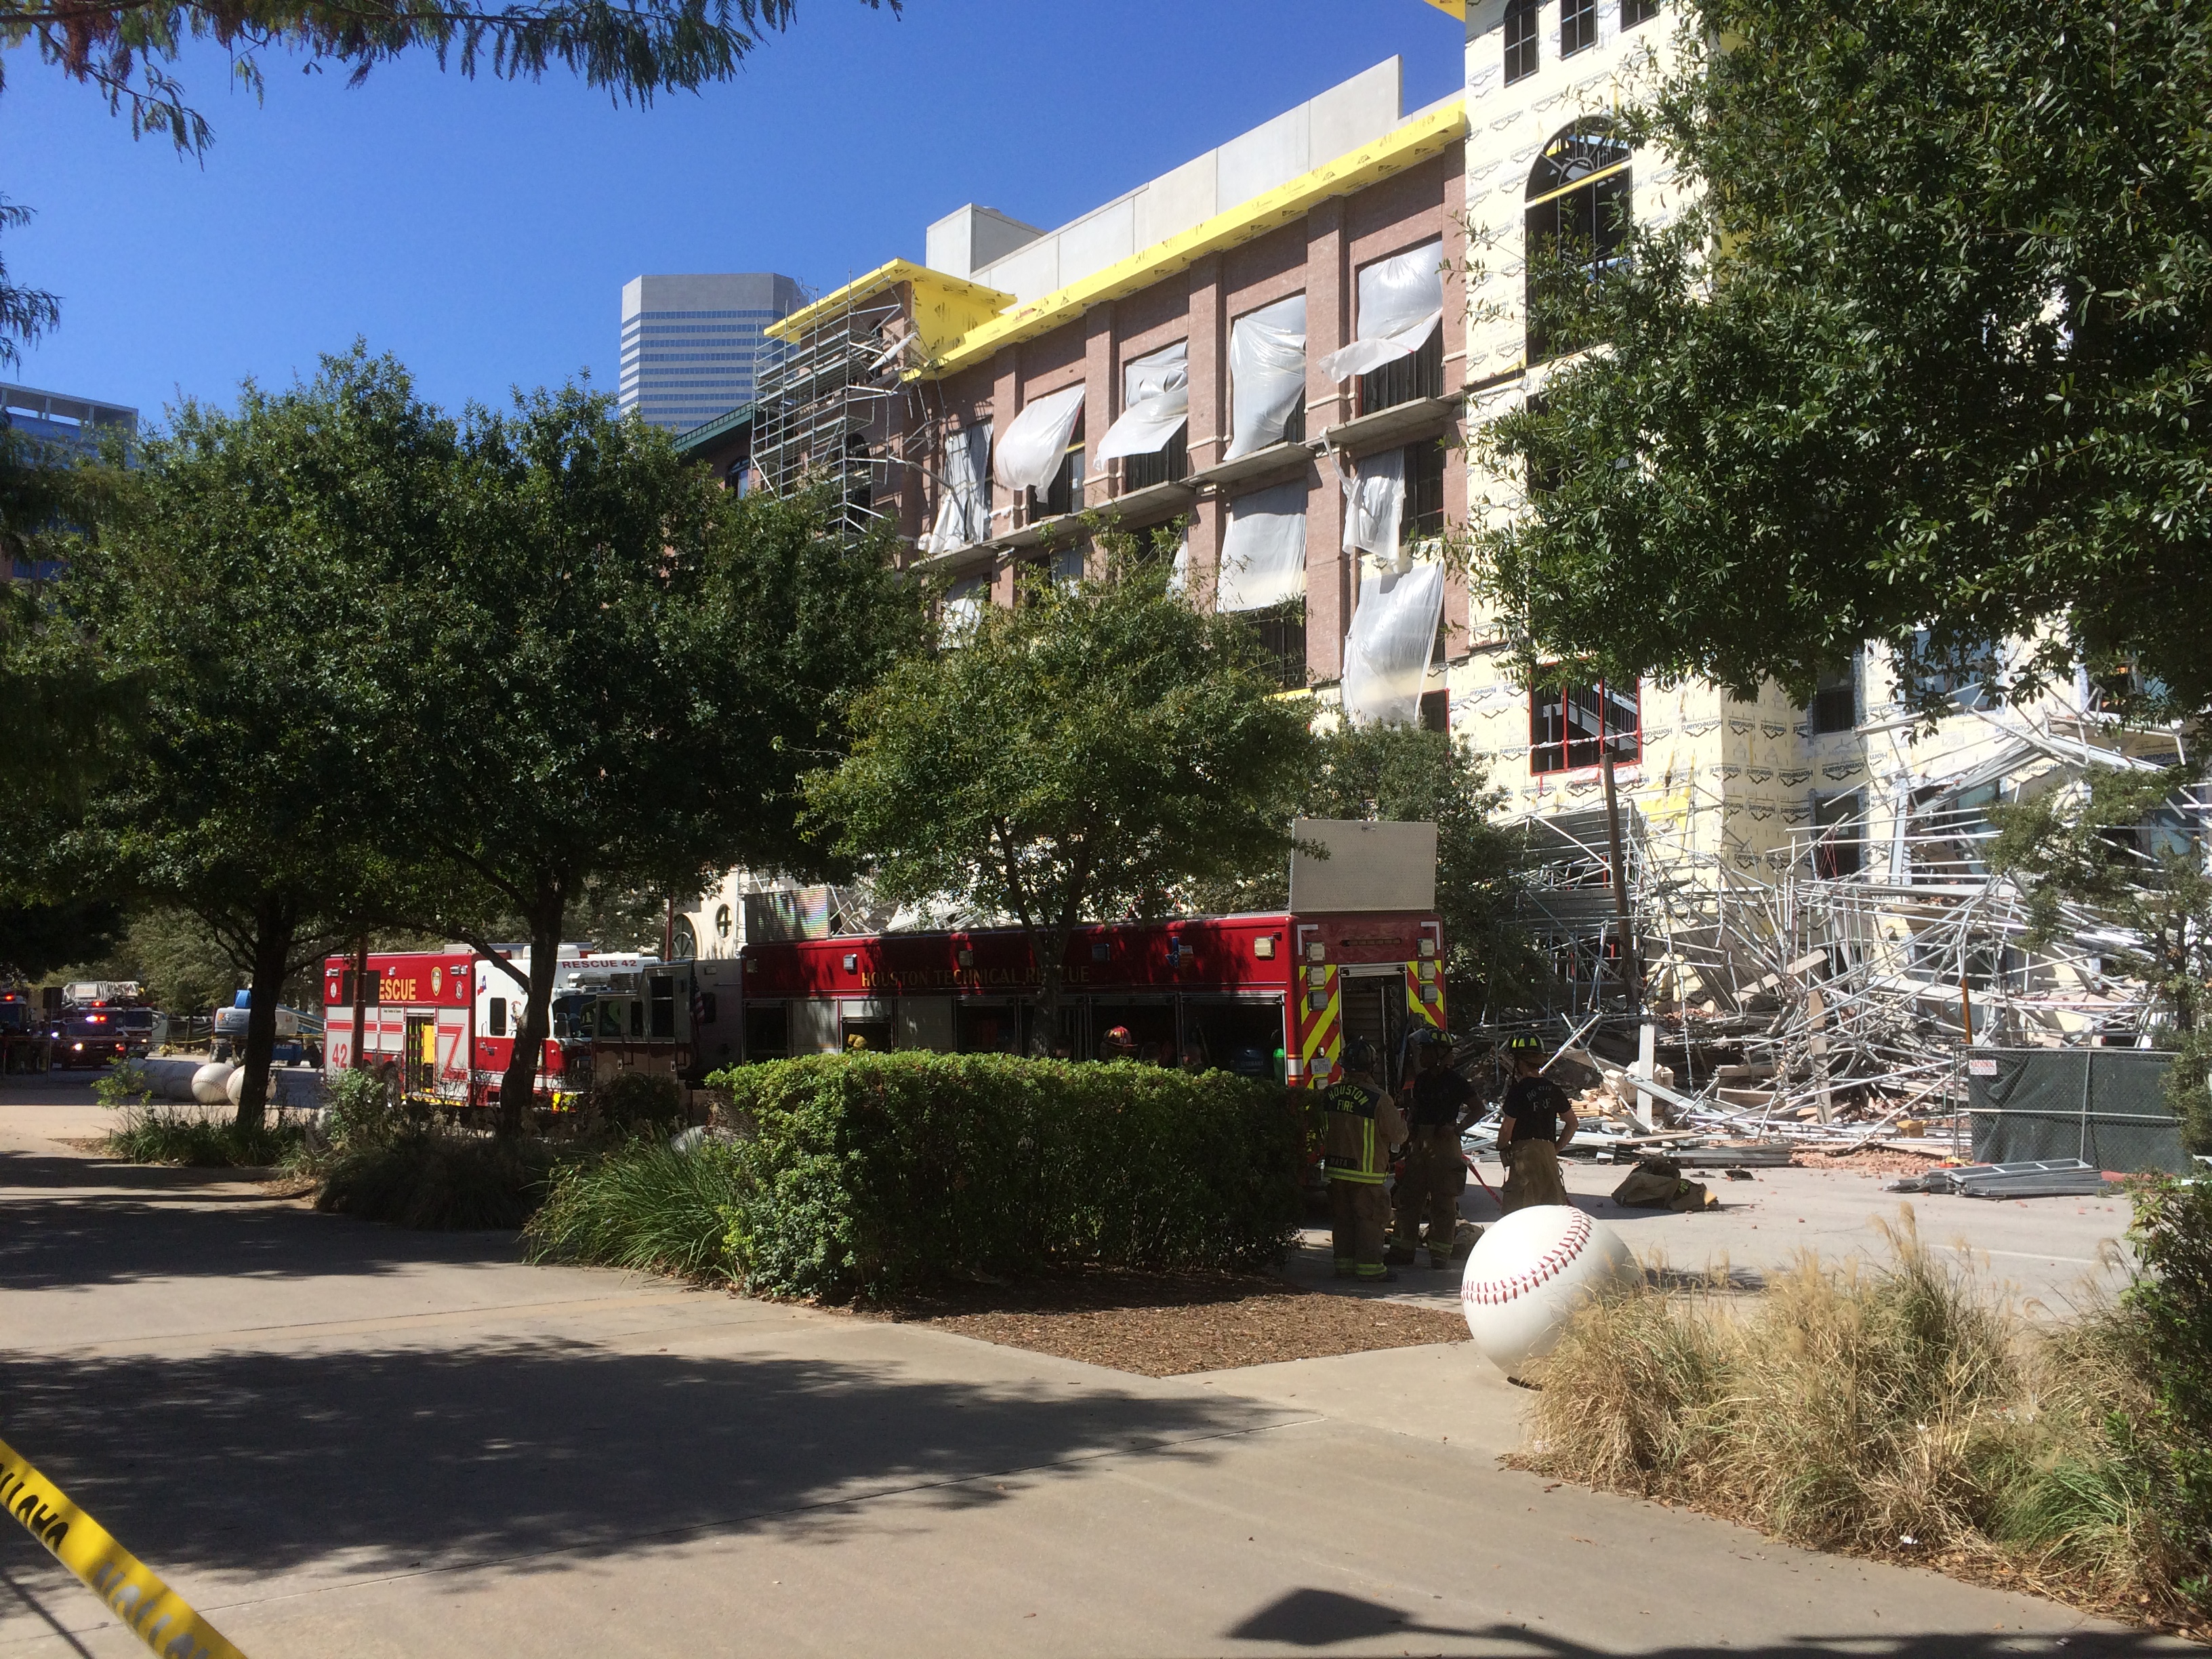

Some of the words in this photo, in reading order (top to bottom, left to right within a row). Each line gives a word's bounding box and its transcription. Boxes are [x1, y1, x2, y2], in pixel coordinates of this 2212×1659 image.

[1681, 719, 1723, 732] HomeGuard
[562, 960, 618, 969] RESCUE
[621, 959, 638, 967] 42
[861, 970, 929, 988] HOUSTON
[935, 968, 1021, 985] TECHNICAL
[379, 979, 417, 1000] ESCUE
[331, 1043, 348, 1069] 42
[1328, 1084, 1370, 1106] HOUSTON
[1337, 1099, 1355, 1113] FIRE
